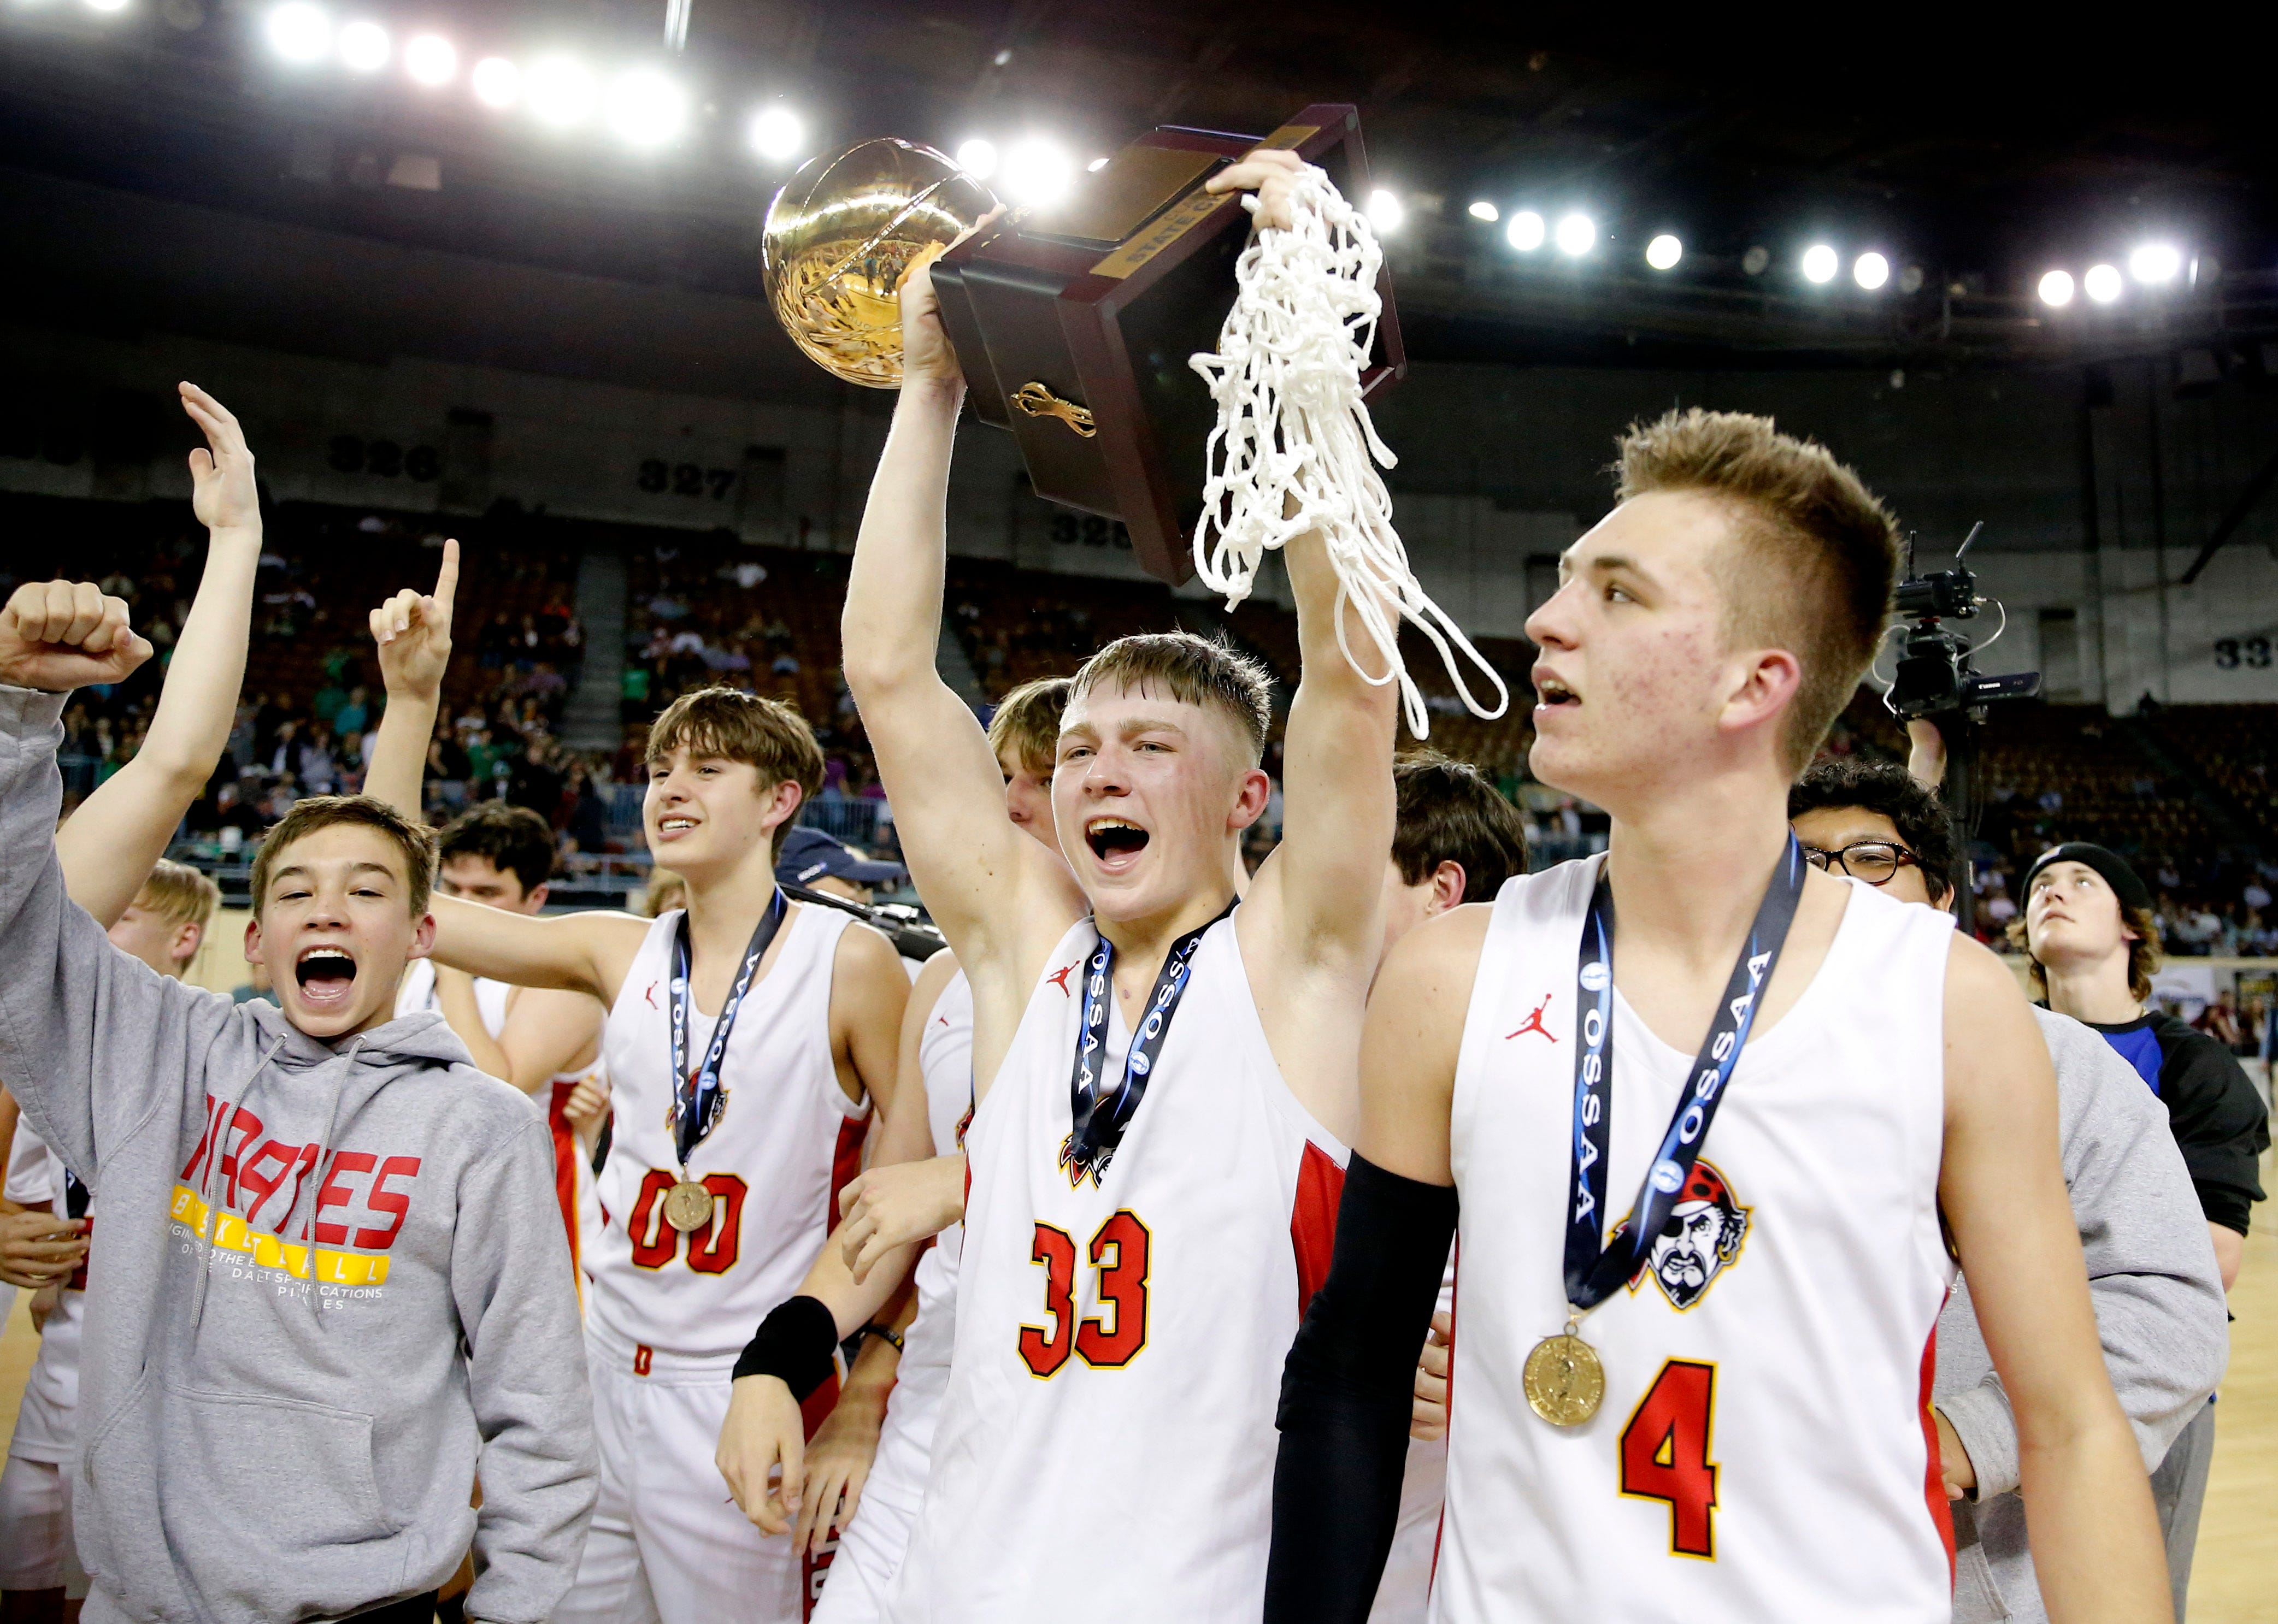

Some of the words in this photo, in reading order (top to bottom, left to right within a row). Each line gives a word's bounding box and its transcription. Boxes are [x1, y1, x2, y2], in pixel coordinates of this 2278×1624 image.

[639, 459, 737, 499] 327
[1079, 953, 1106, 1094] OSSAA
[1679, 950, 1771, 1145] OSSAA
[1575, 1008, 1602, 1224] OSSAA
[219, 1251, 245, 1265] THE
[628, 1167, 748, 1274] 00
[1016, 1207, 1153, 1381] 33
[1617, 1355, 1721, 1563] 4
